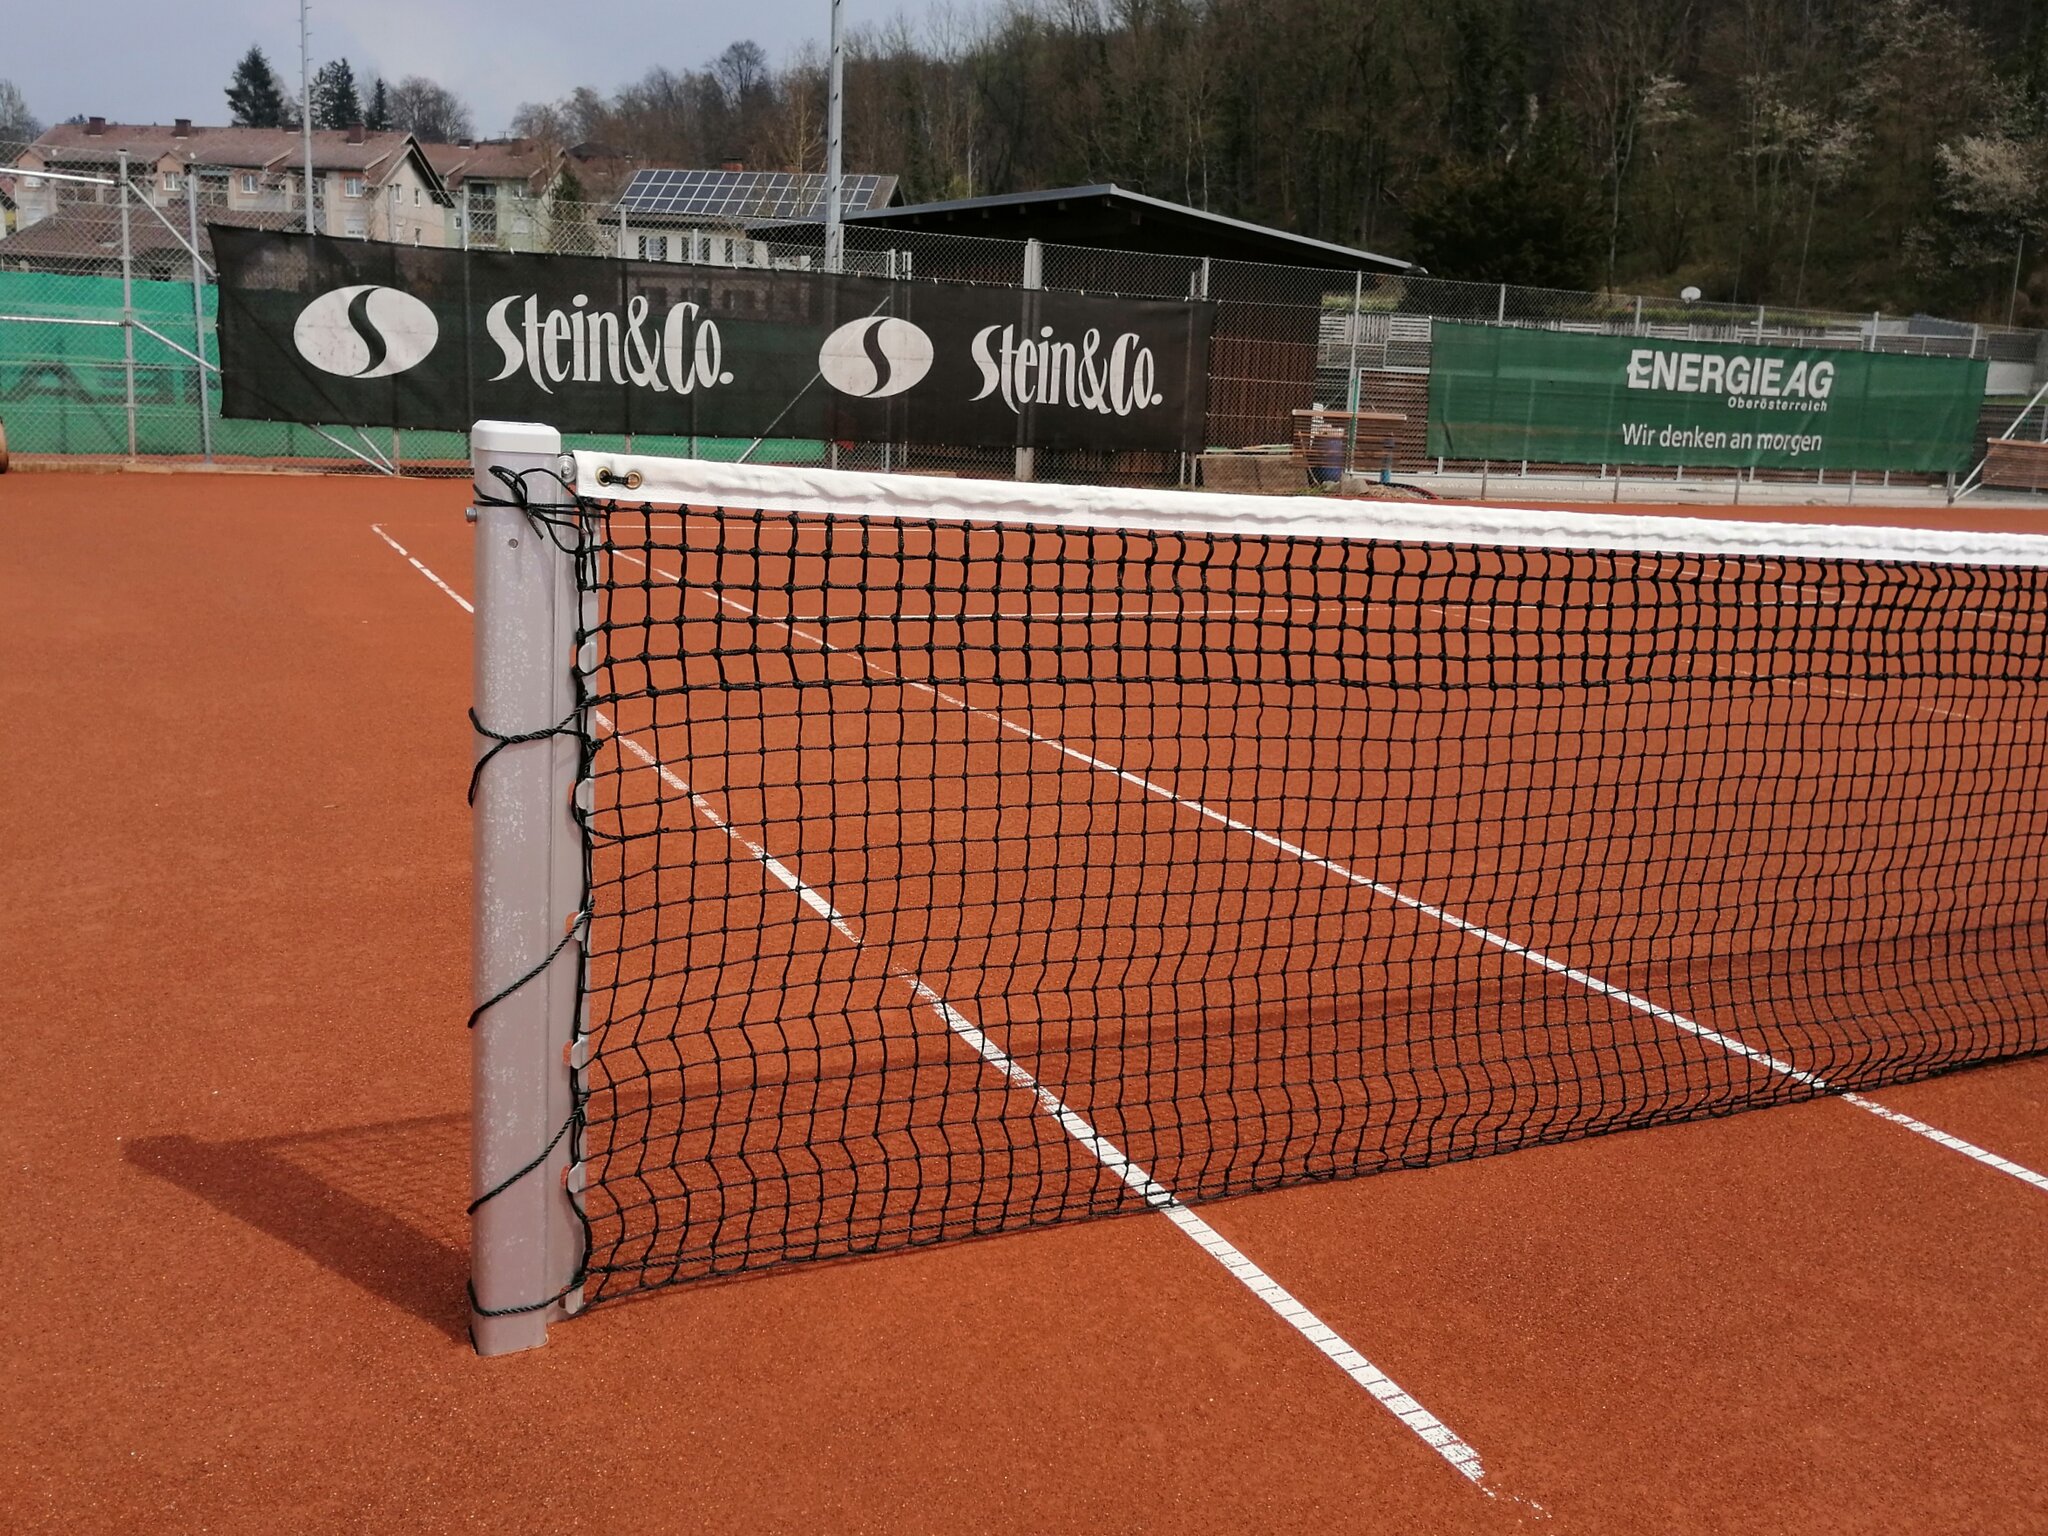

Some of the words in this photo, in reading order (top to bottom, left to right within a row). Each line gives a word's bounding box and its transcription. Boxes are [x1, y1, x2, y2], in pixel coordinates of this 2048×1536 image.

[486, 293, 734, 395] Stein&Co.
[969, 322, 1163, 417] Stein&Co.
[1627, 349, 1784, 396] ENERGIE
[1782, 360, 1835, 399] AG
[1727, 396, 1828, 412] Oberösterreich
[1622, 422, 1656, 446] Wir
[1659, 423, 1726, 449] denken
[1729, 430, 1753, 450] an
[1756, 430, 1823, 456] morgen
